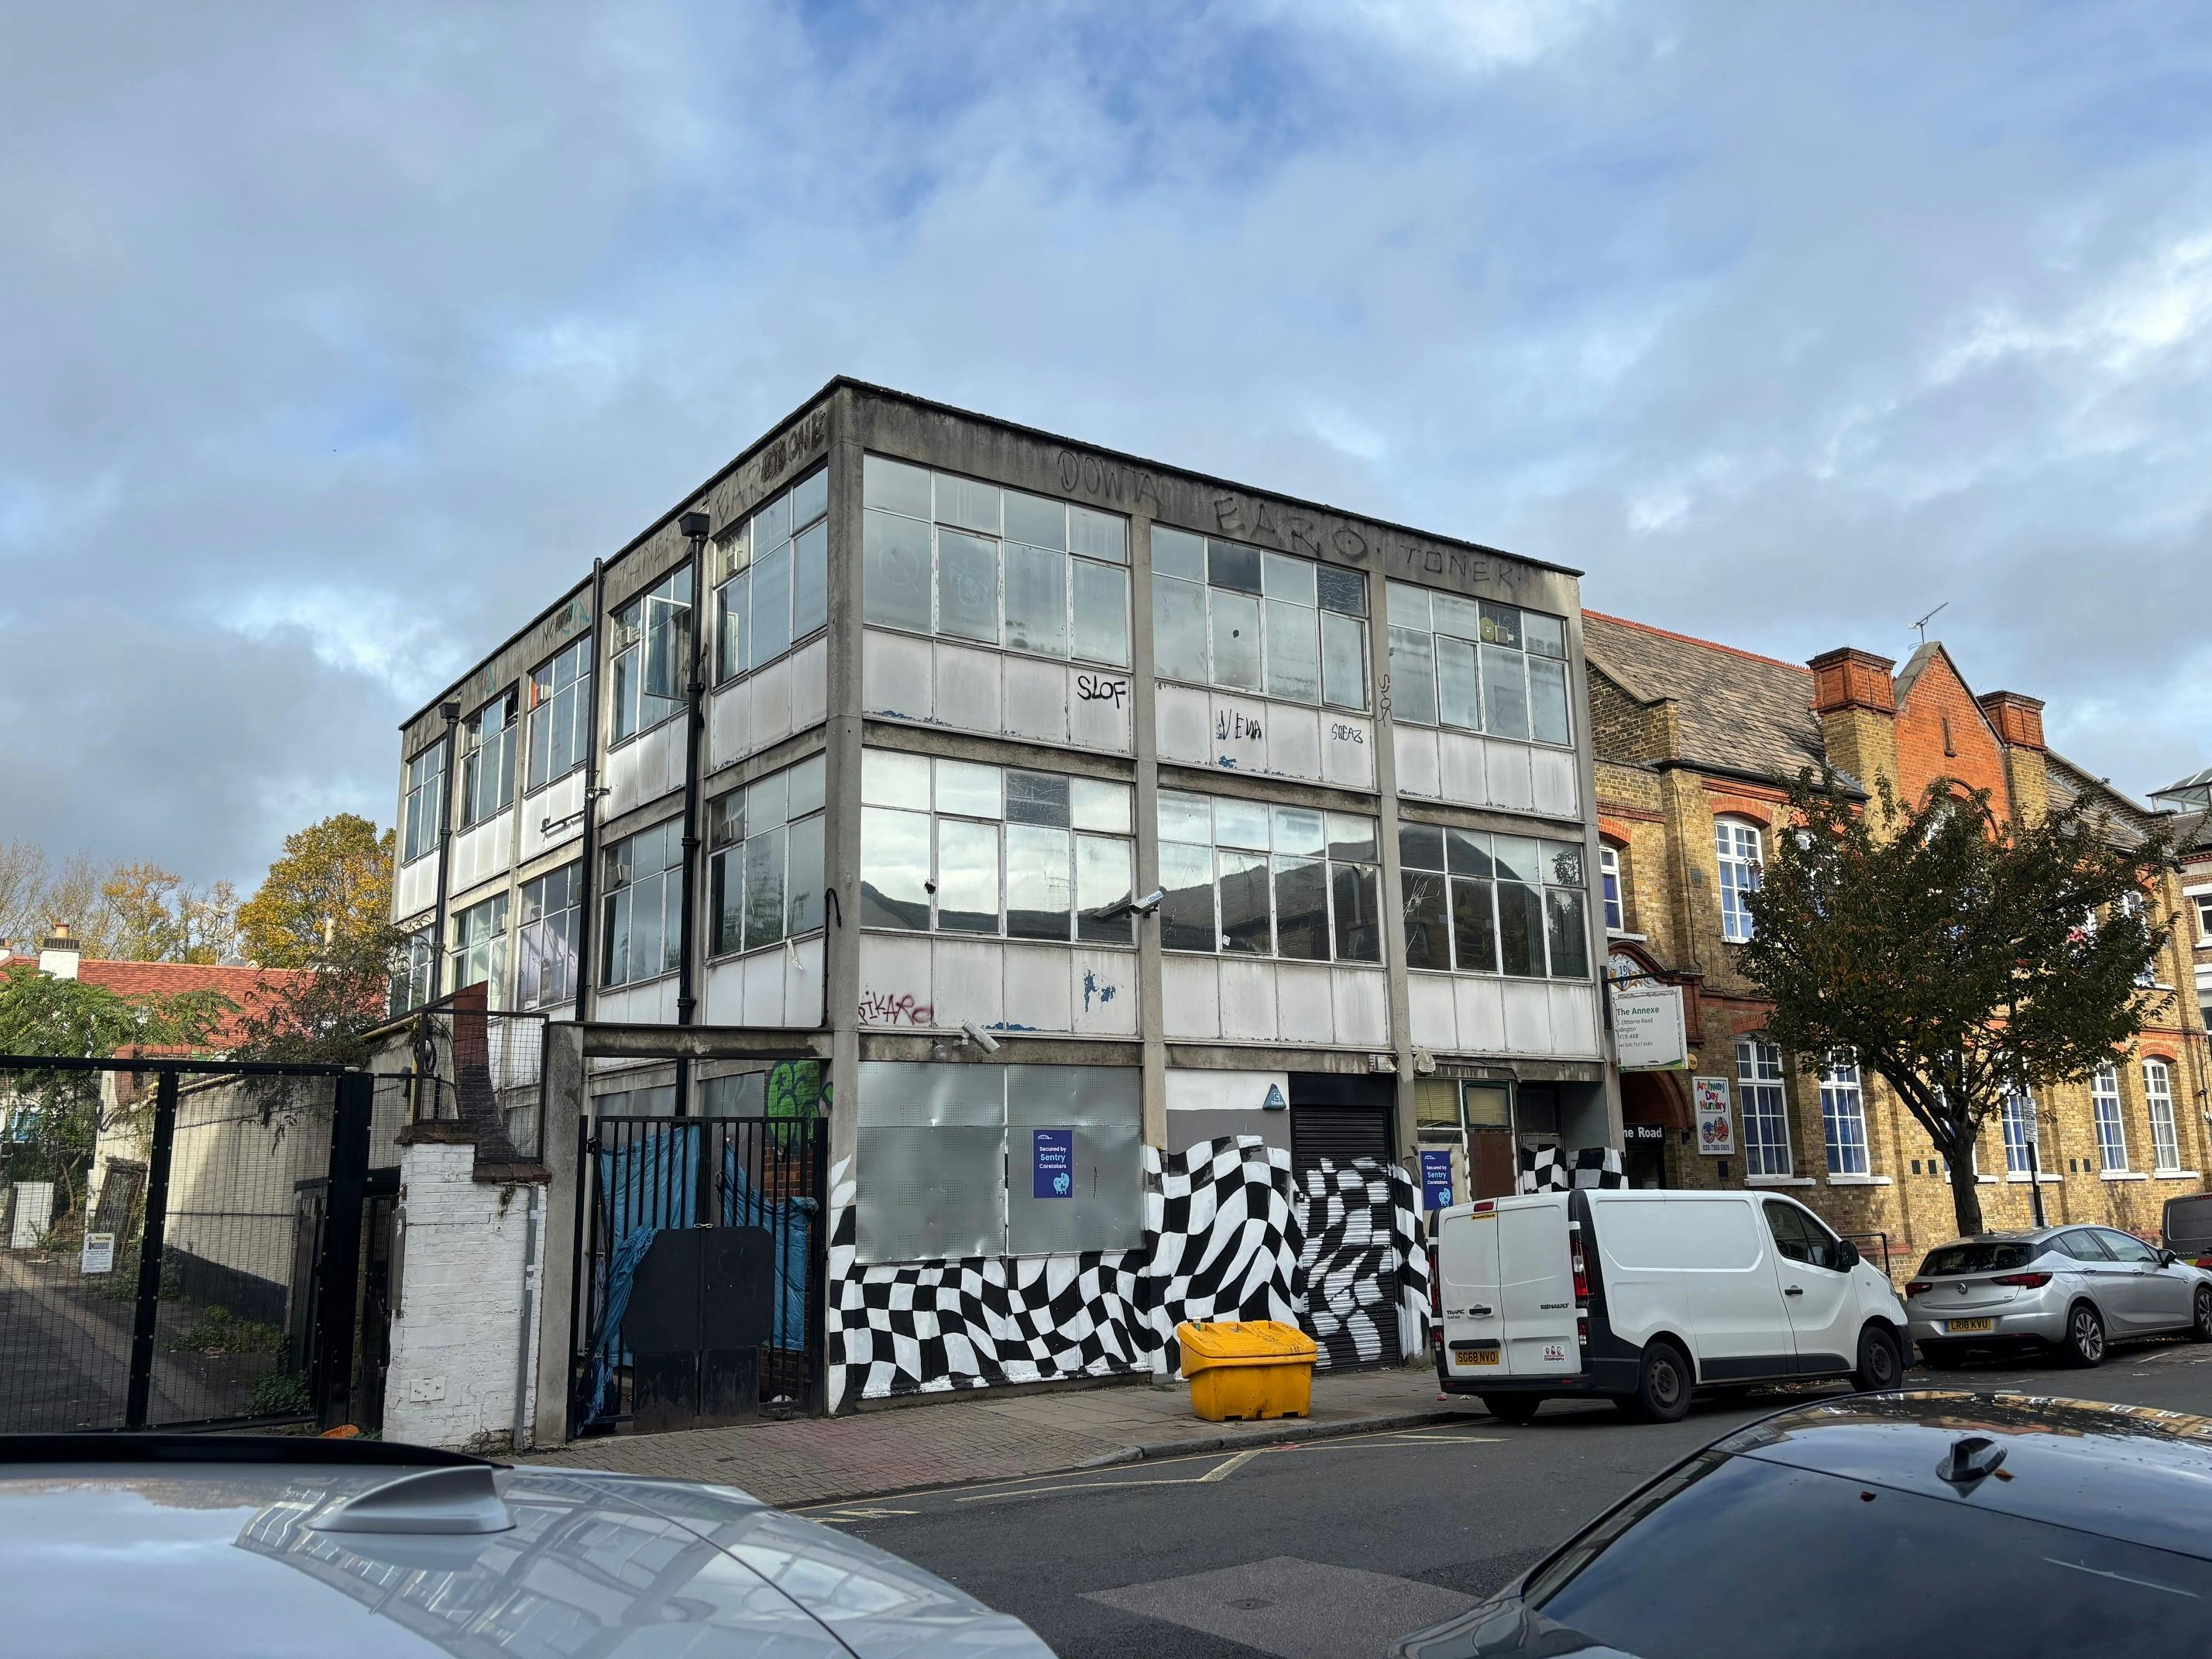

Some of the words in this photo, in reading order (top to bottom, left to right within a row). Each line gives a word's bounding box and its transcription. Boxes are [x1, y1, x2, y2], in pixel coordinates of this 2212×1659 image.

[1077, 675, 1126, 709] SLOF
[1632, 1006, 1660, 1015] Annexe
[1697, 1080, 1725, 1094] Archway
[1705, 1091, 1719, 1103] Day
[1699, 1100, 1726, 1112] Nursery
[1637, 1126, 1662, 1138] Road
[1040, 1153, 1066, 1163] Sentry
[1427, 1171, 1447, 1180] Sentry
[1951, 1321, 1970, 1330] LR18
[1970, 1321, 1988, 1329] KVU
[1458, 1350, 1479, 1362] SG68
[1479, 1349, 1496, 1362] NVO
